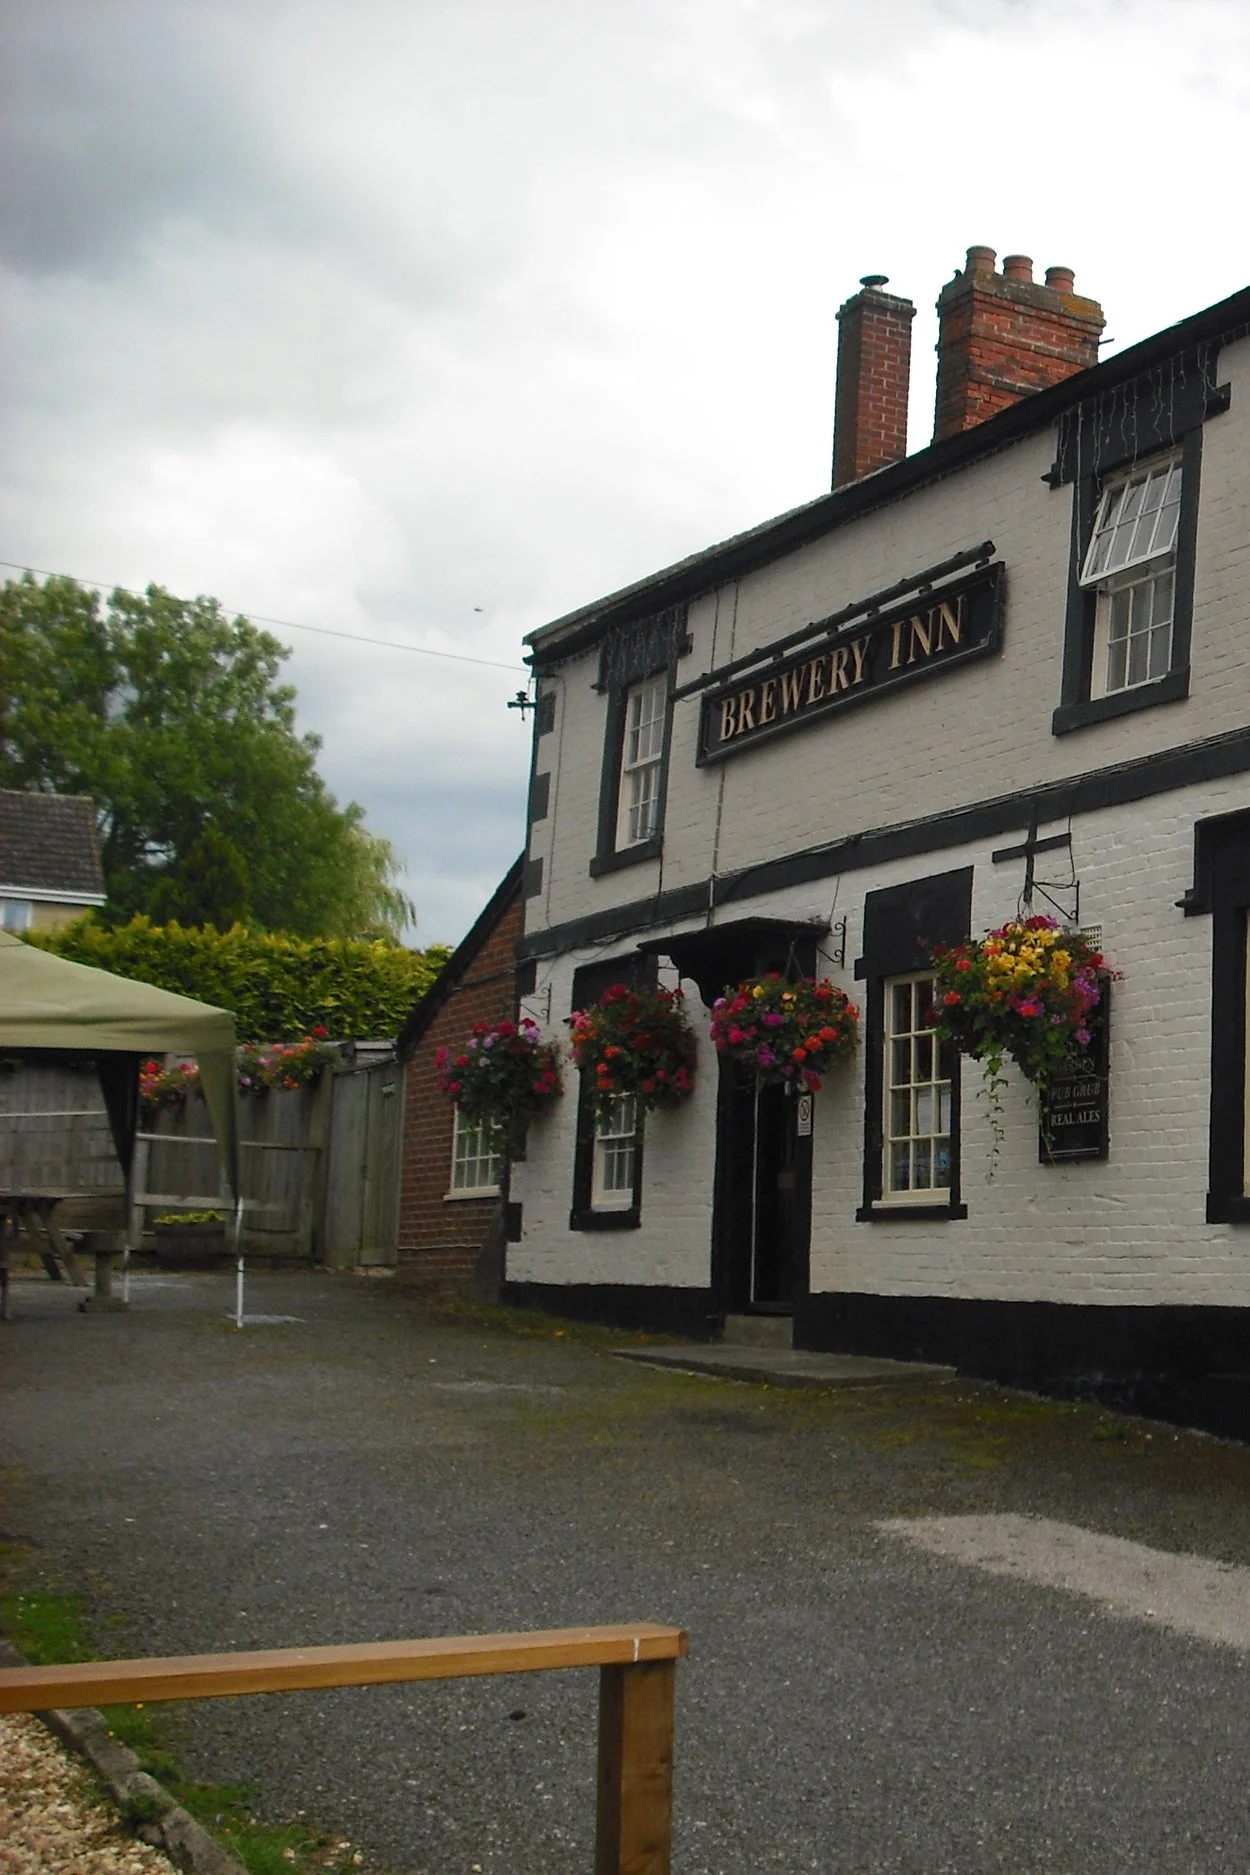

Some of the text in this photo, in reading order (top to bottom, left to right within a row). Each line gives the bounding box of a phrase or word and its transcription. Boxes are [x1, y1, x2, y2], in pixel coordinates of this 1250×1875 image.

[718, 595, 965, 742] BREWERY INN
[1052, 1086, 1071, 1100] PUB
[1051, 1109, 1101, 1127] REAL ALES
